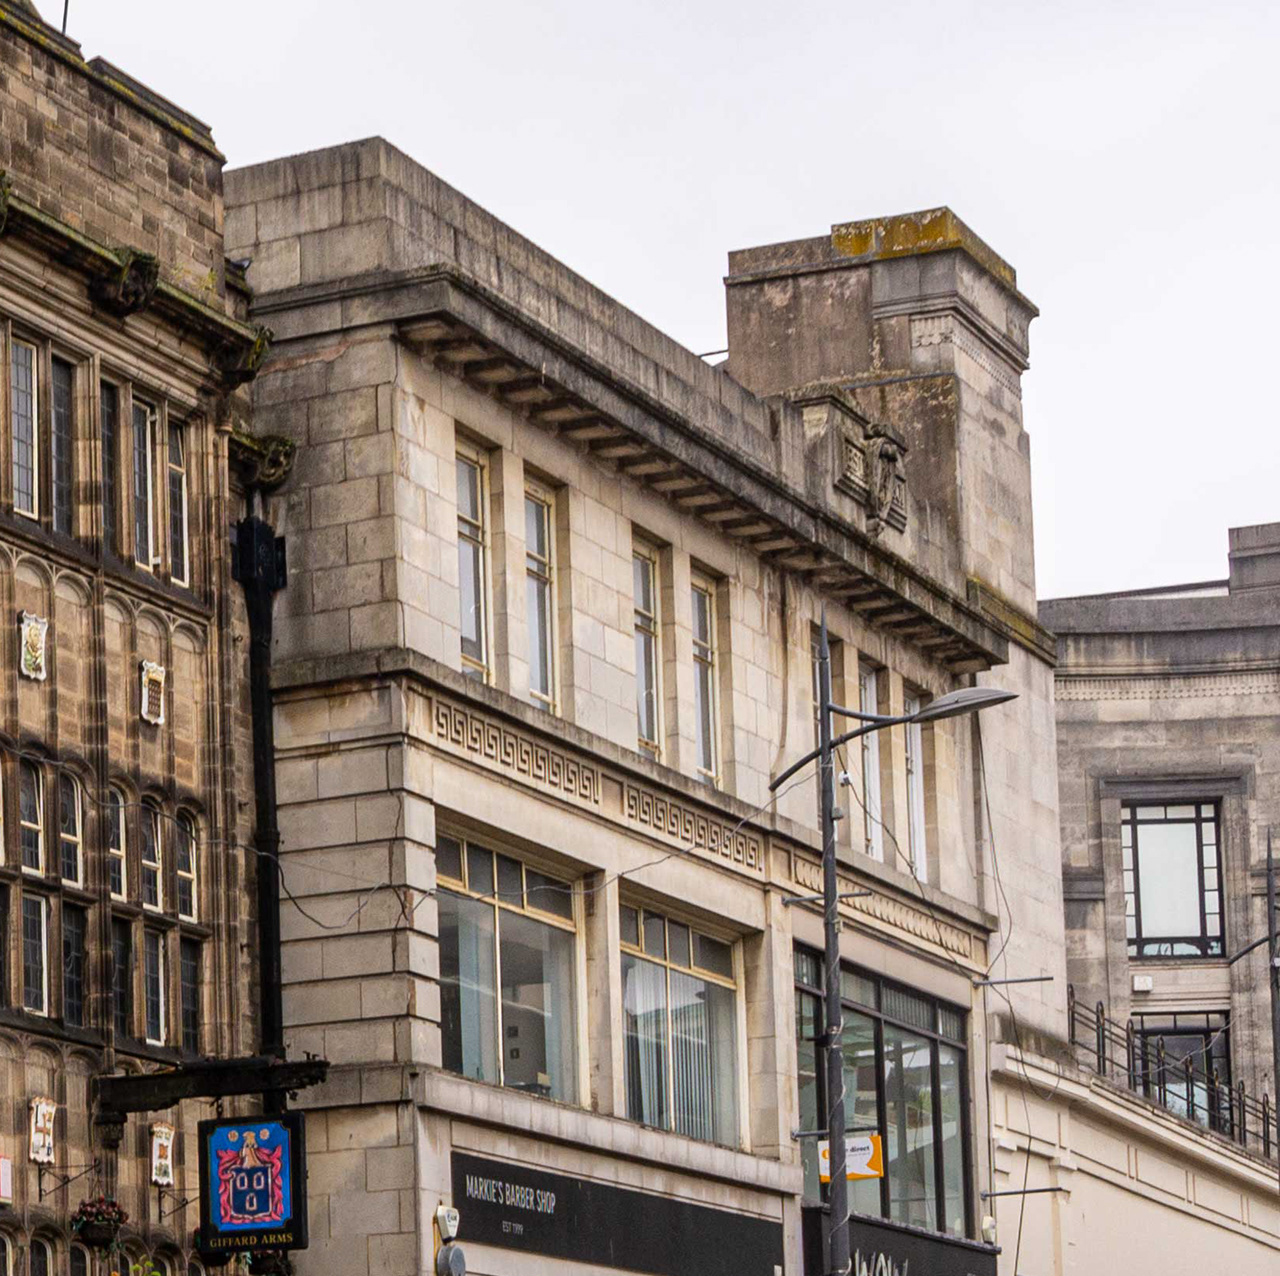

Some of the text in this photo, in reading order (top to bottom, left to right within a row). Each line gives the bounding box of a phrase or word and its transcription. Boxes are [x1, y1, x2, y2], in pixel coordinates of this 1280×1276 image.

[466, 1174, 556, 1214] MARKIE'S BARBER SHOP
[210, 1232, 294, 1249] GIFFARD ARMS
